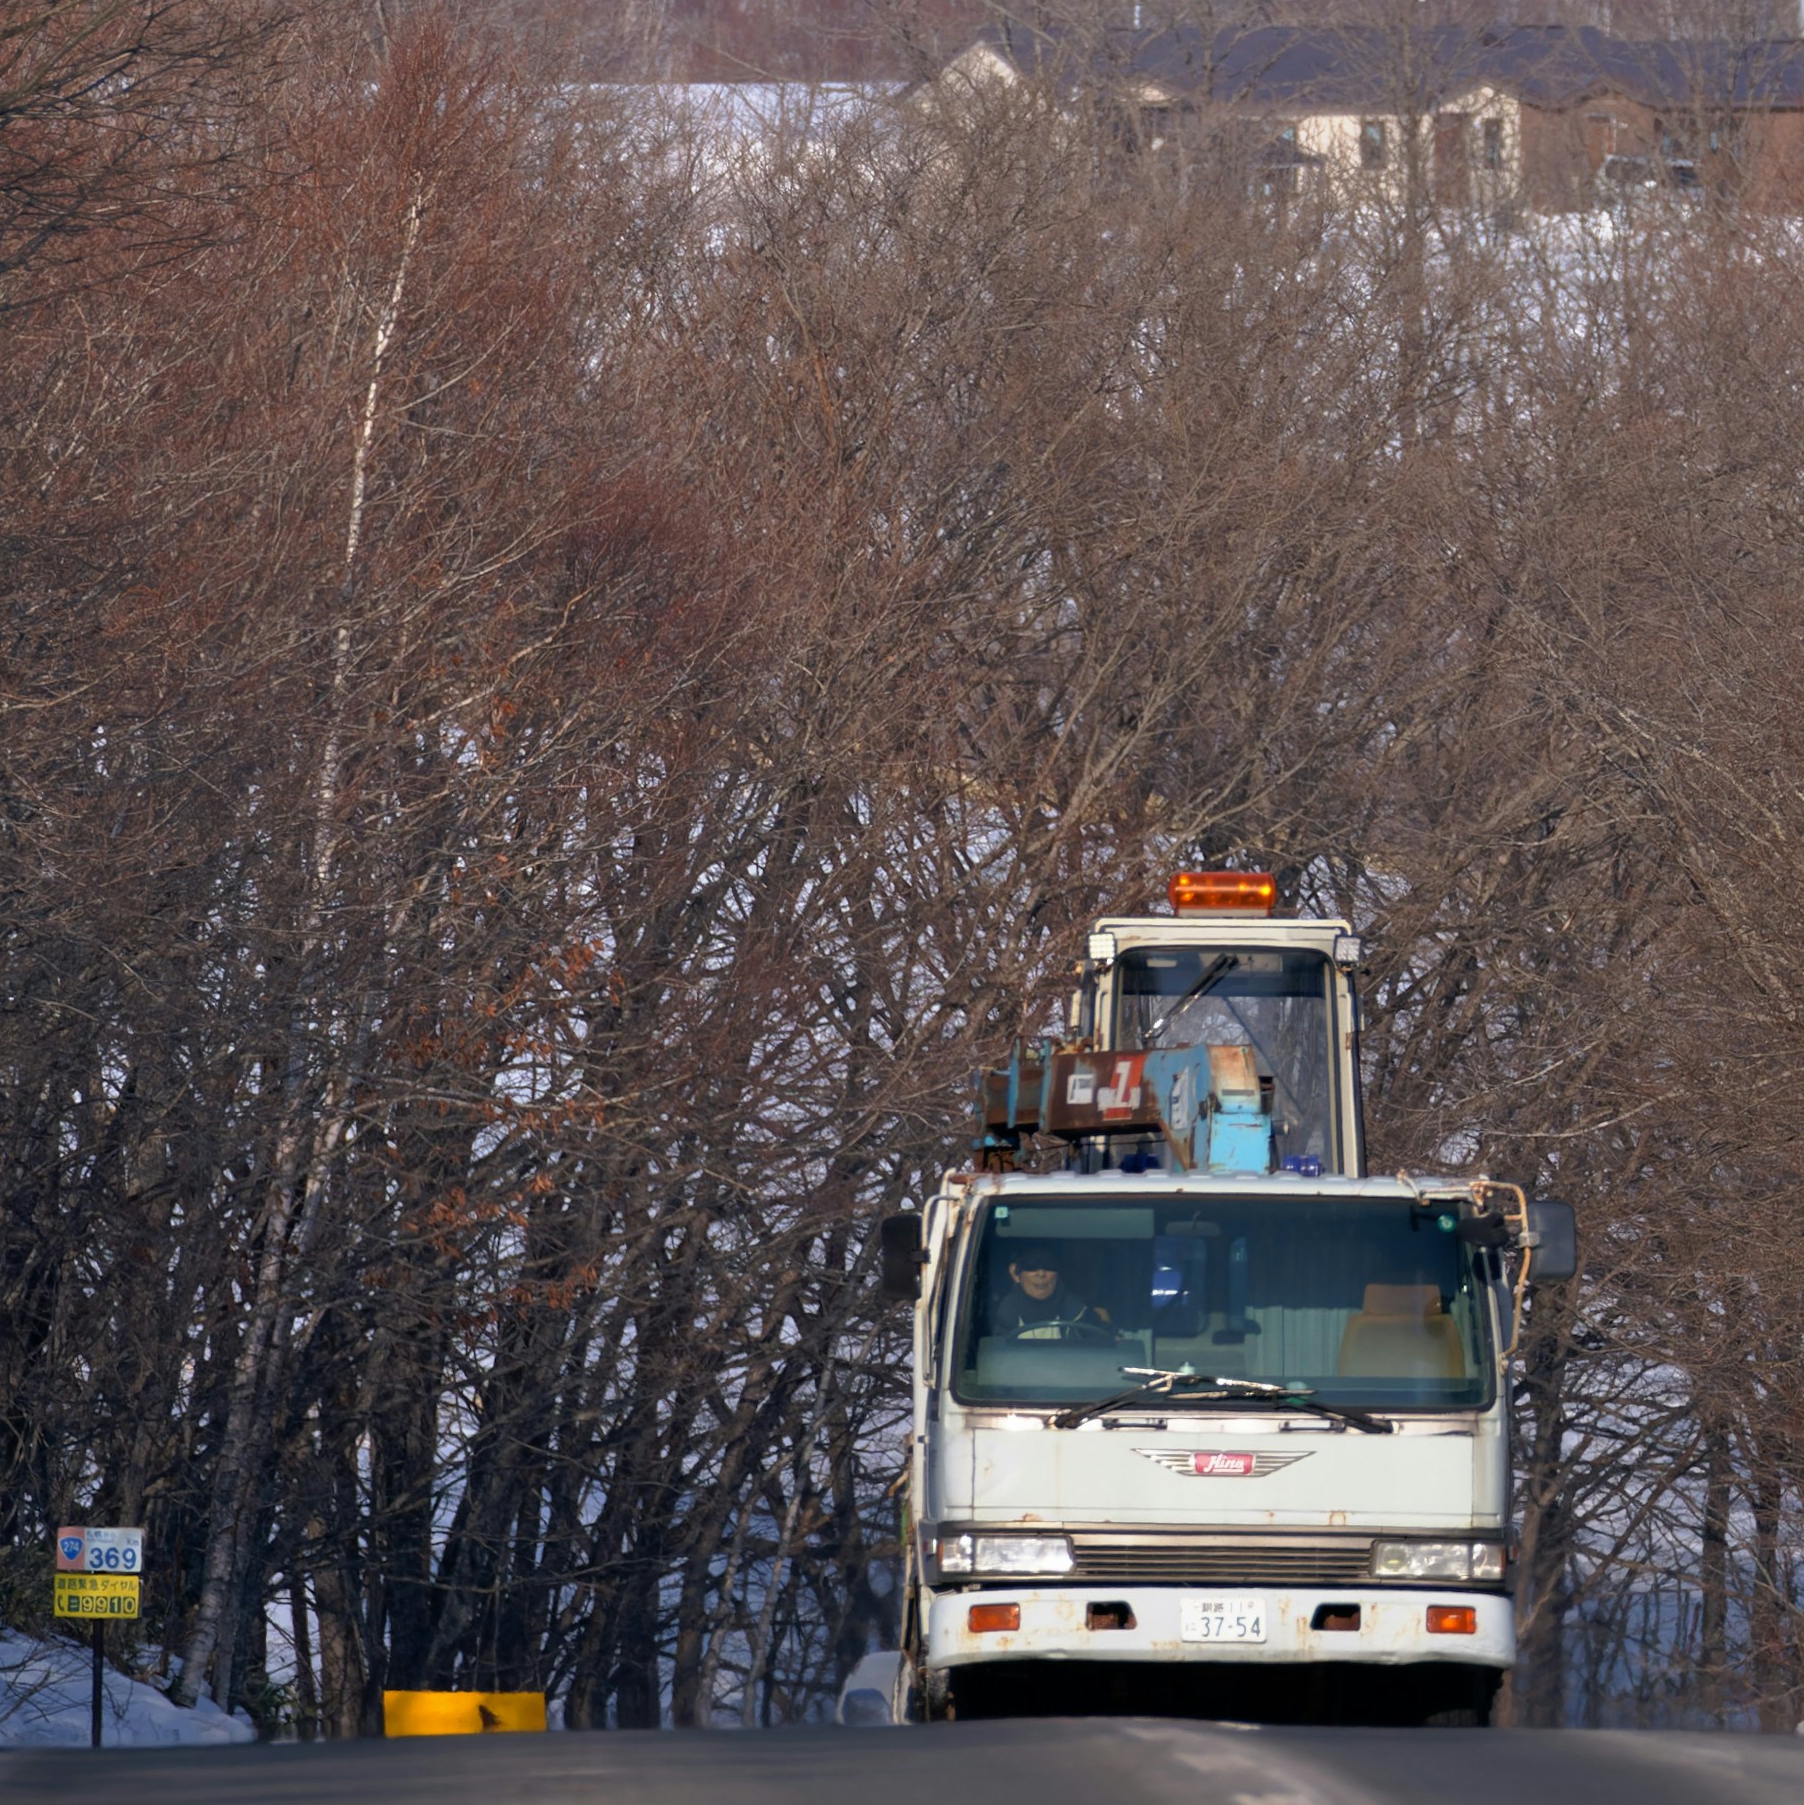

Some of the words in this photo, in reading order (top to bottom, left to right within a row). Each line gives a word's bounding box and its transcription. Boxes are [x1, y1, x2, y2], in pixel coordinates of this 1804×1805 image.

[1203, 1453, 1245, 1473] Hino
[63, 1540, 80, 1552] 274
[89, 1547, 137, 1570] 369
[57, 1578, 136, 1592] 道路緊急ダイヤル
[1201, 1616, 1261, 1637] 37-54
